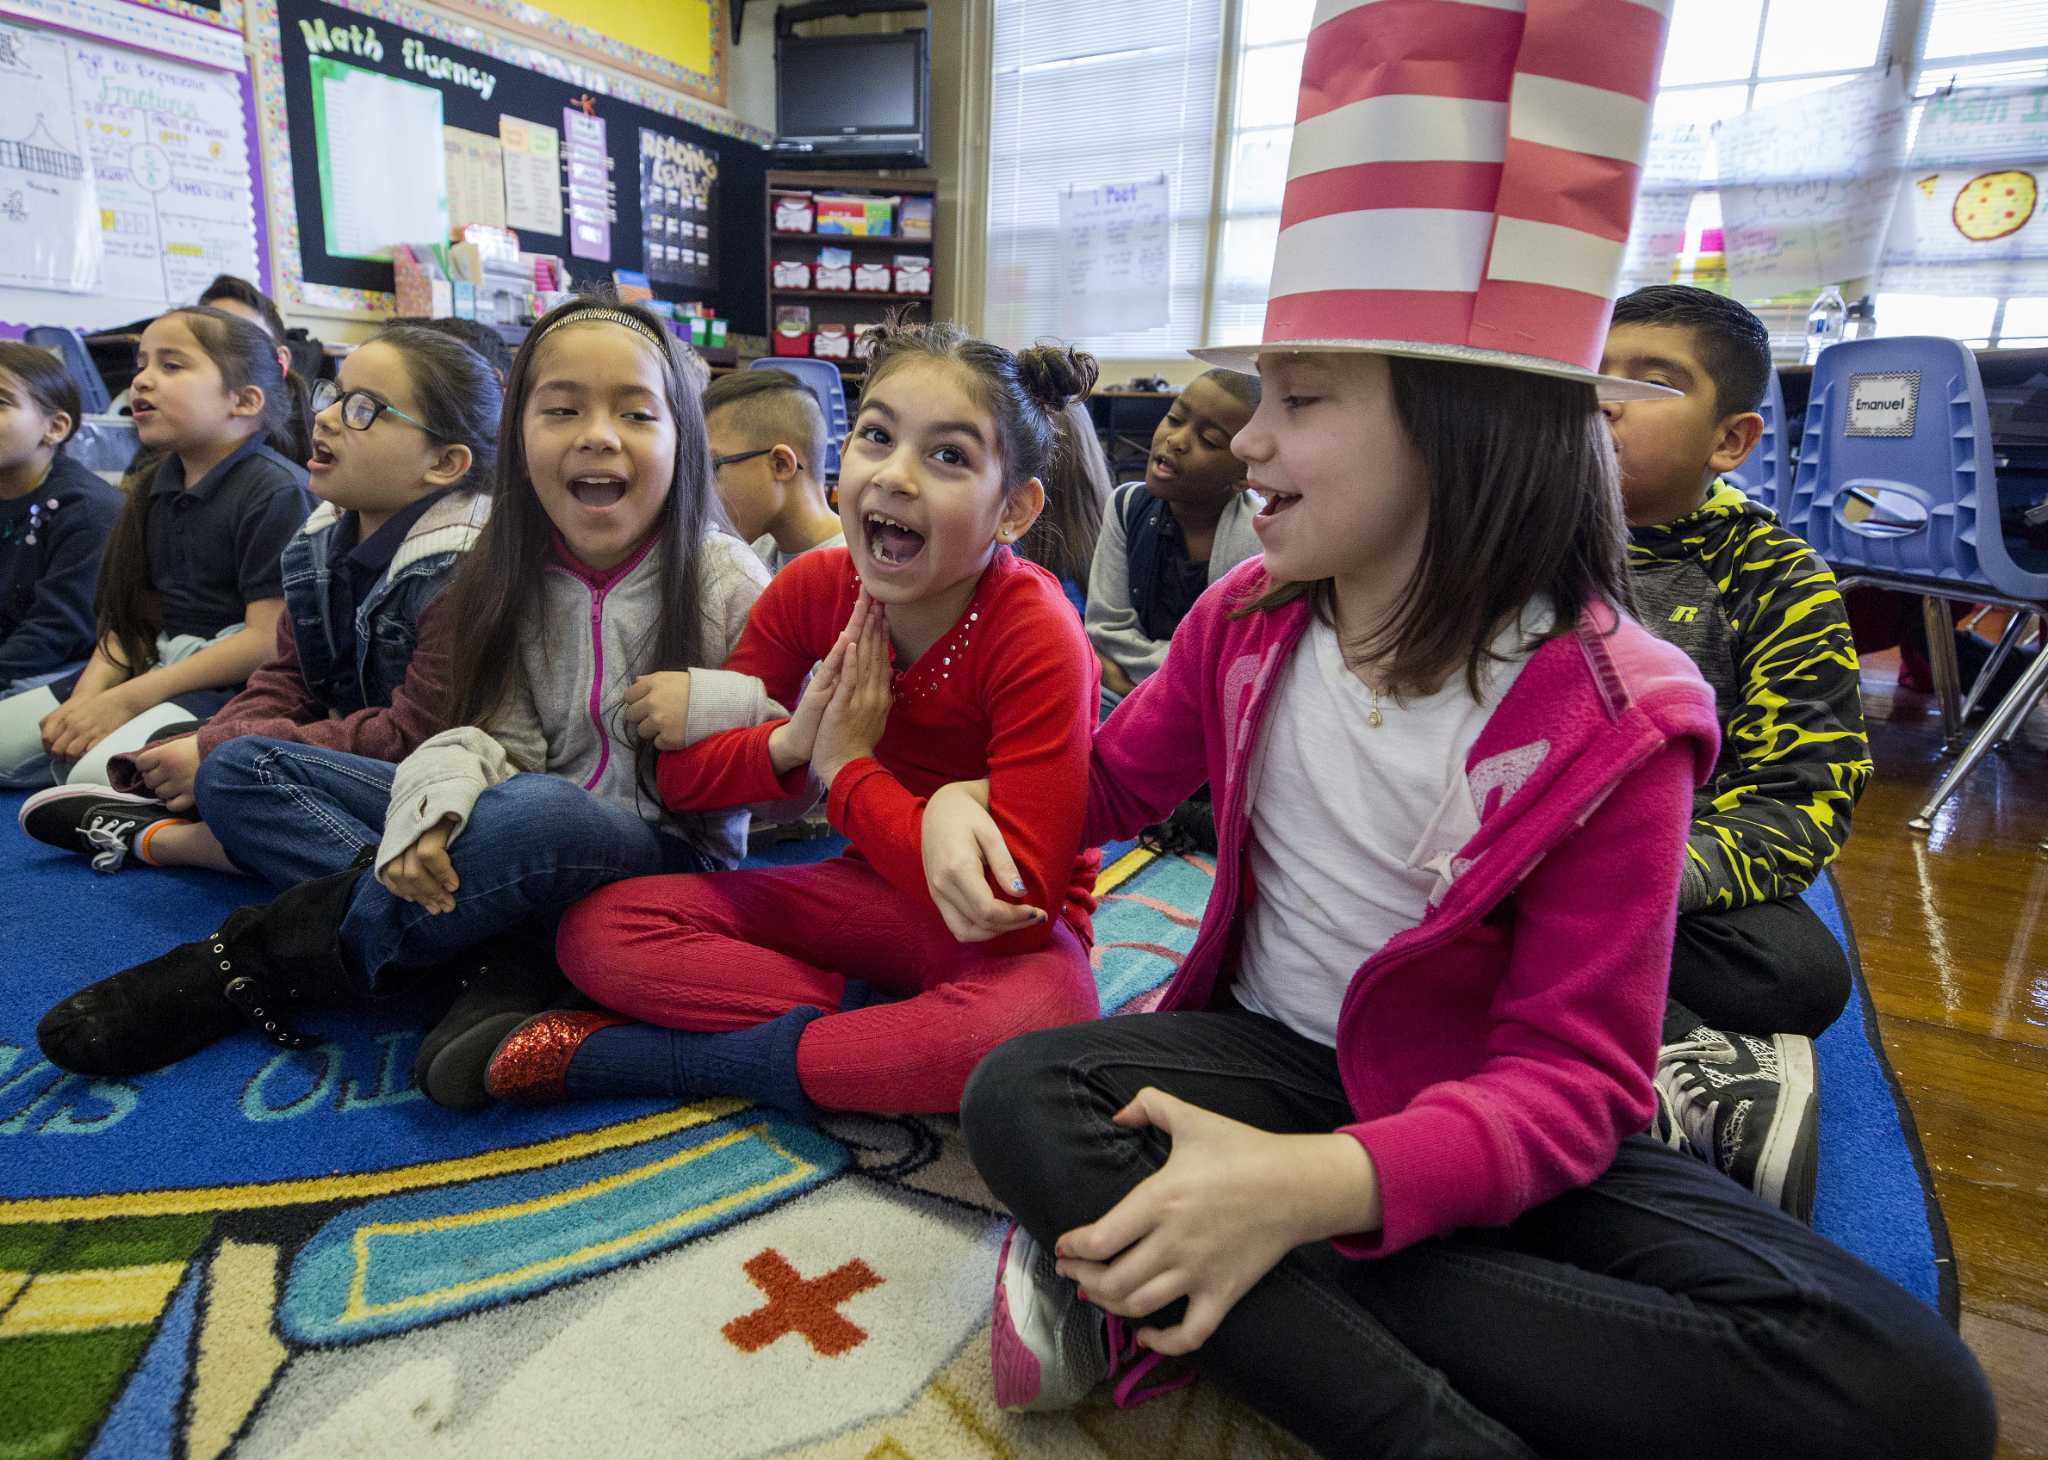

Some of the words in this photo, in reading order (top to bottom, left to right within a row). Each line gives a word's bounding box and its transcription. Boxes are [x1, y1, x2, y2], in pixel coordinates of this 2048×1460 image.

[299, 18, 384, 62] Math
[402, 38, 496, 100] fluency
[1856, 398, 1905, 411] Emanuel
